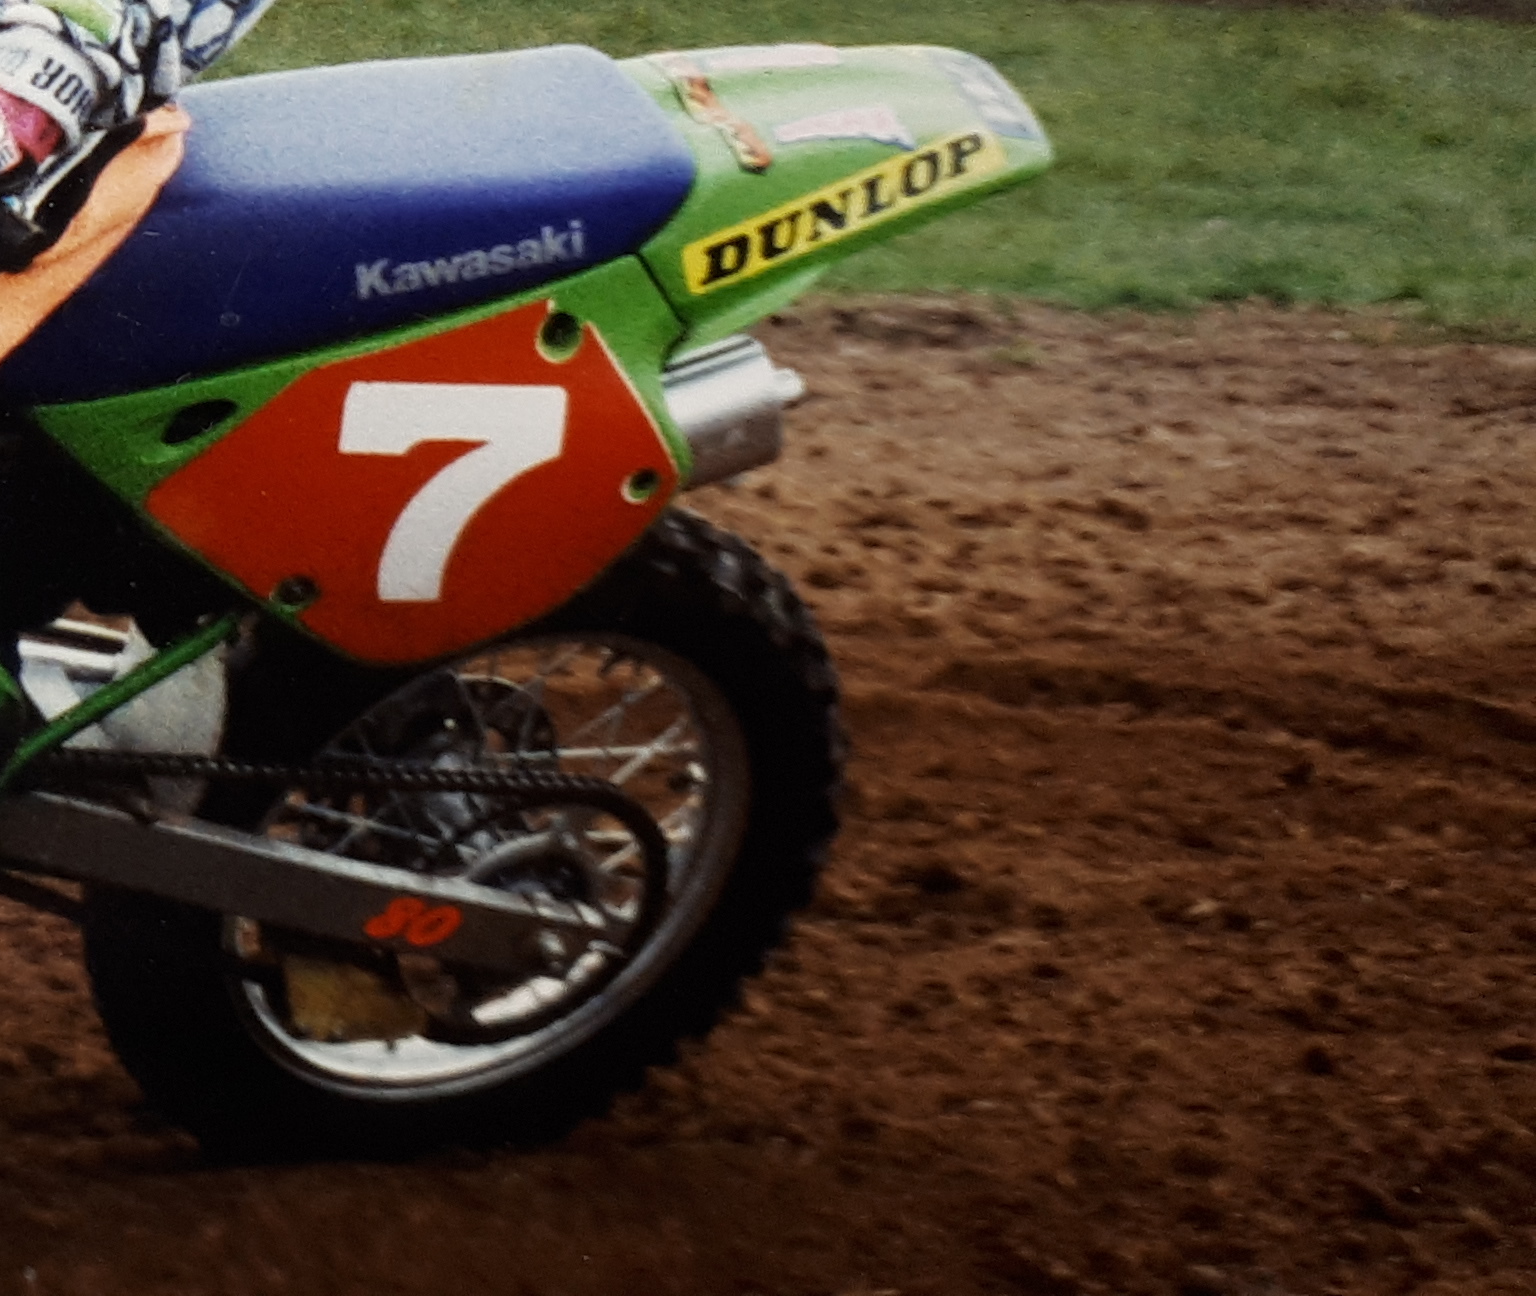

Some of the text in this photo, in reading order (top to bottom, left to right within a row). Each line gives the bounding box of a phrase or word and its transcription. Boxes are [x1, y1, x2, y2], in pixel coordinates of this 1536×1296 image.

[354, 218, 585, 301] Kawasaki
[701, 131, 984, 286] DUNLOP
[338, 379, 570, 603] 7
[362, 895, 463, 947] 80
